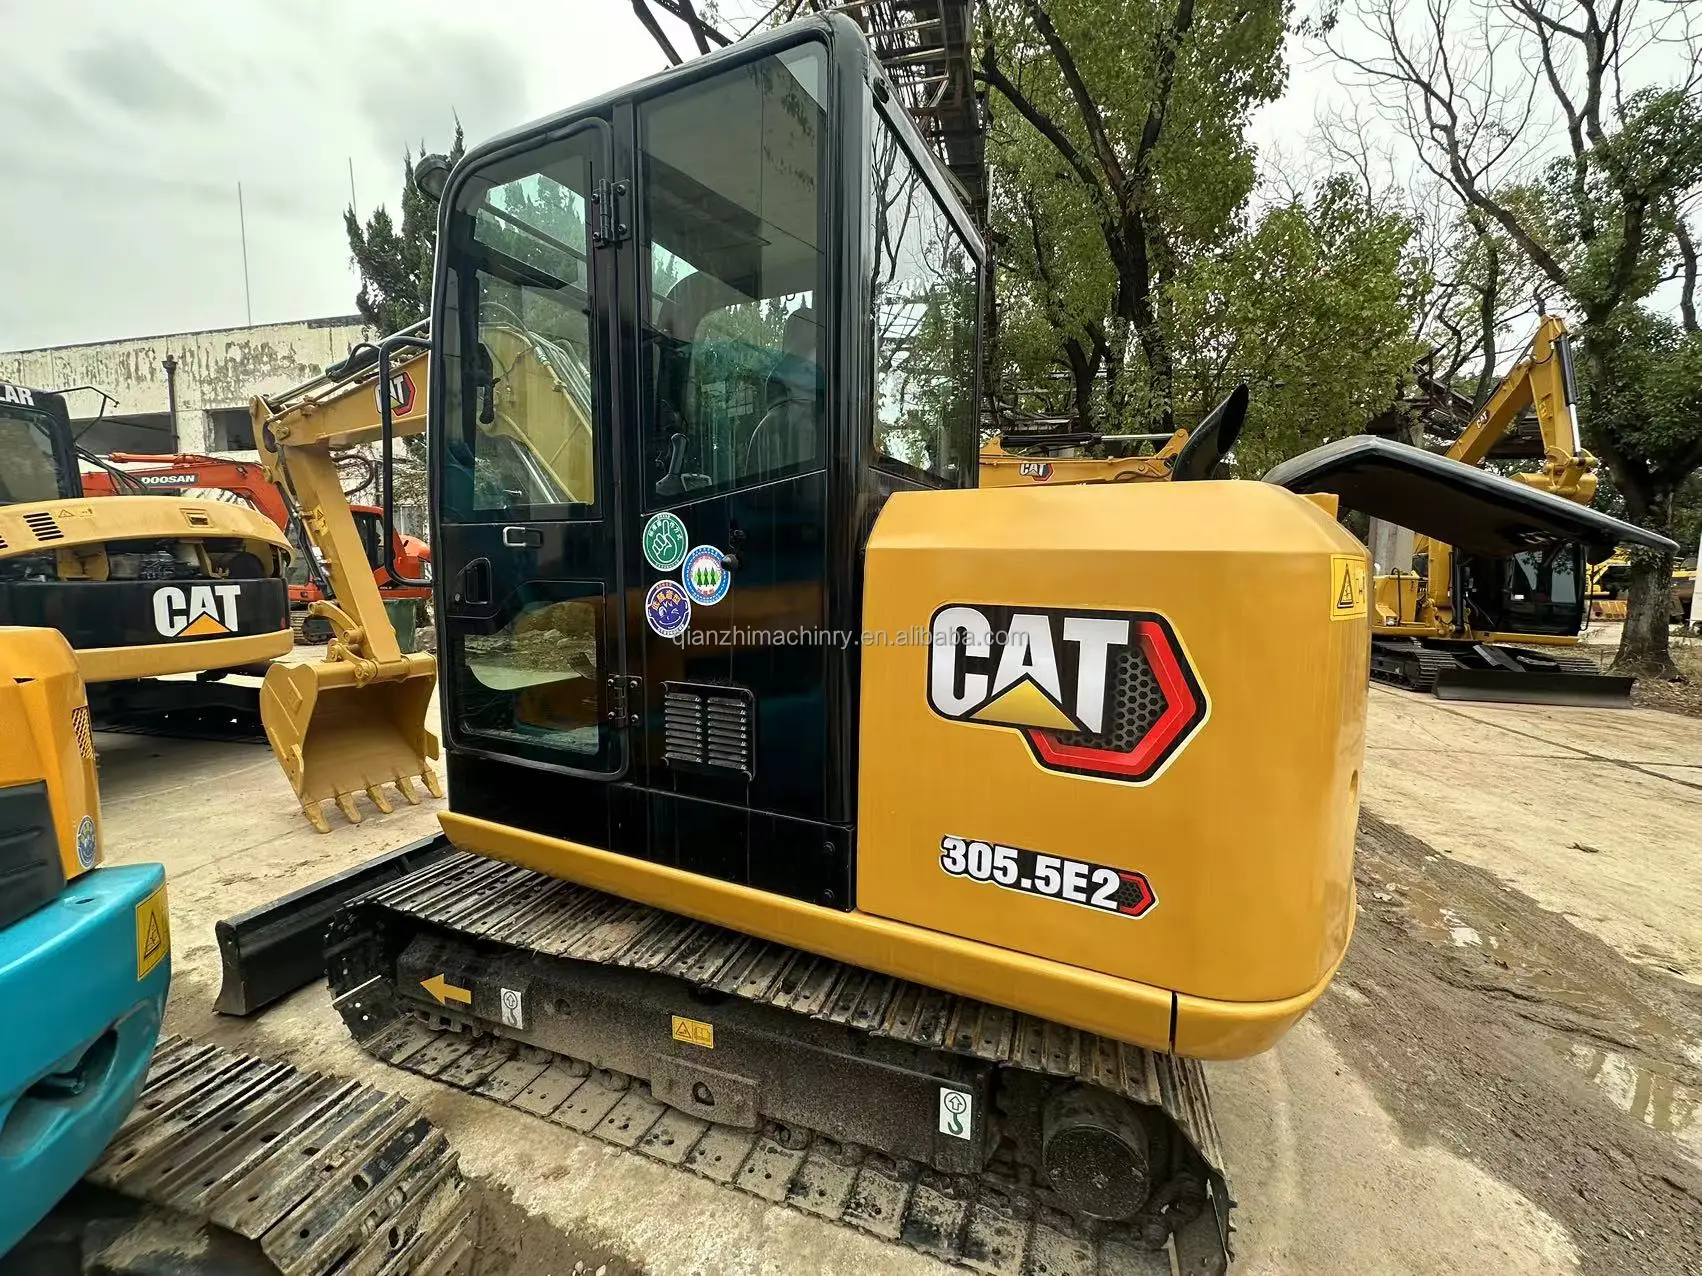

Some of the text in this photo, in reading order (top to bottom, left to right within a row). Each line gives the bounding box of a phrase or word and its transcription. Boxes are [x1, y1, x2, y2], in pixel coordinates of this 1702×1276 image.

[140, 475, 196, 484] DOOSAN
[1020, 463, 1046, 477] CAT
[152, 584, 241, 637] CAT
[931, 606, 1130, 734] CAT
[942, 837, 1121, 910] 305.5E2
